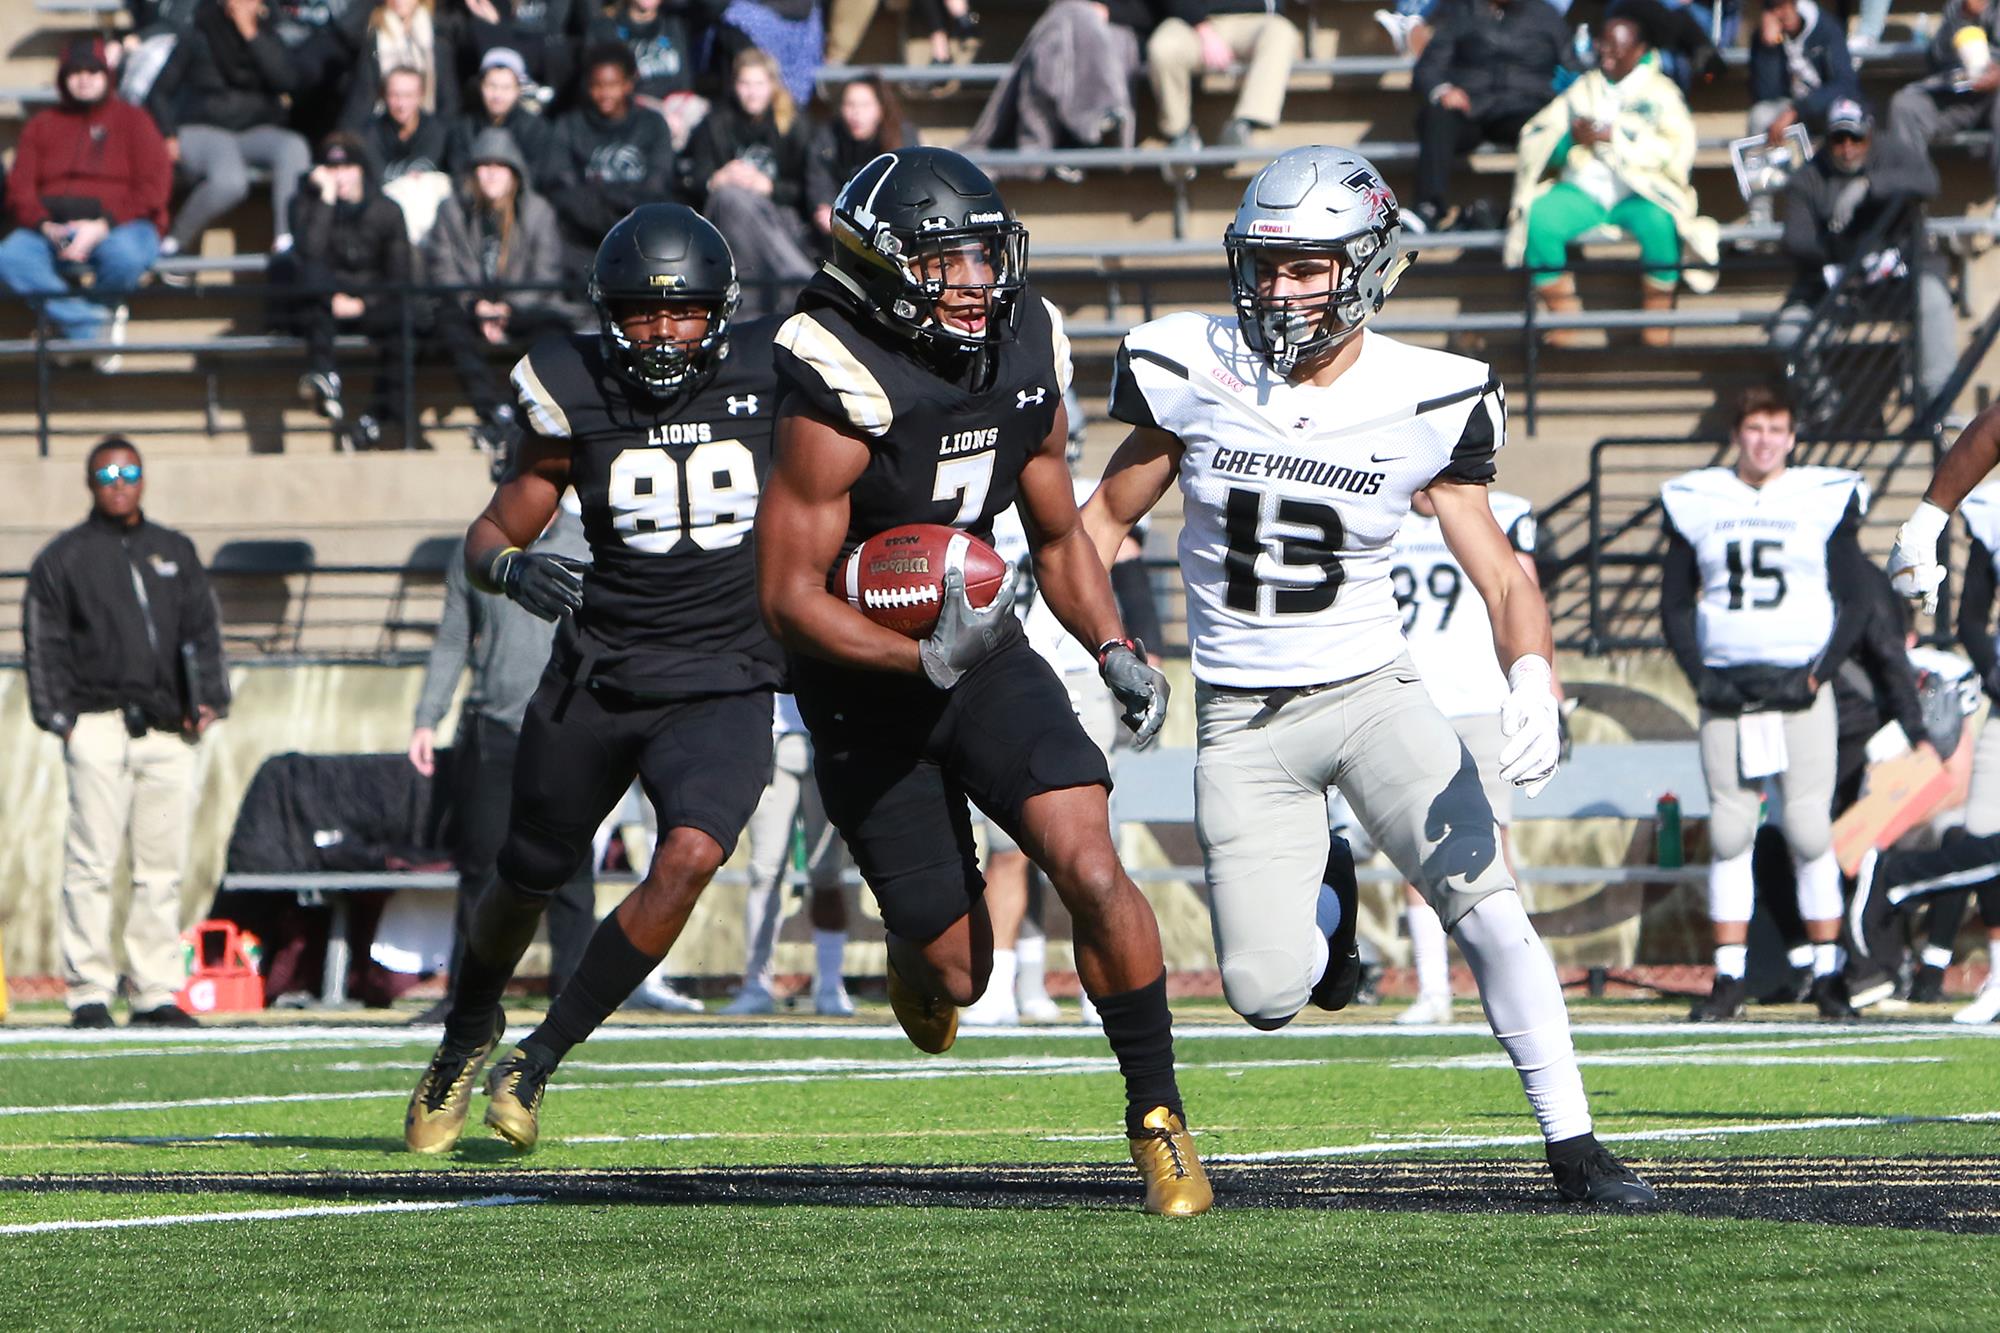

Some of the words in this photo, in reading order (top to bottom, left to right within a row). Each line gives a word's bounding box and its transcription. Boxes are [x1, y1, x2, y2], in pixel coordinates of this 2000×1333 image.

[647, 423, 712, 446] LIONS
[939, 427, 999, 455] LIONS
[608, 438, 760, 554] 88
[931, 448, 997, 528] 7
[1211, 446, 1386, 496] GREYHOUNDS
[870, 557, 929, 574] Wilson
[1224, 486, 1347, 616] 13
[1725, 538, 1788, 611] 15
